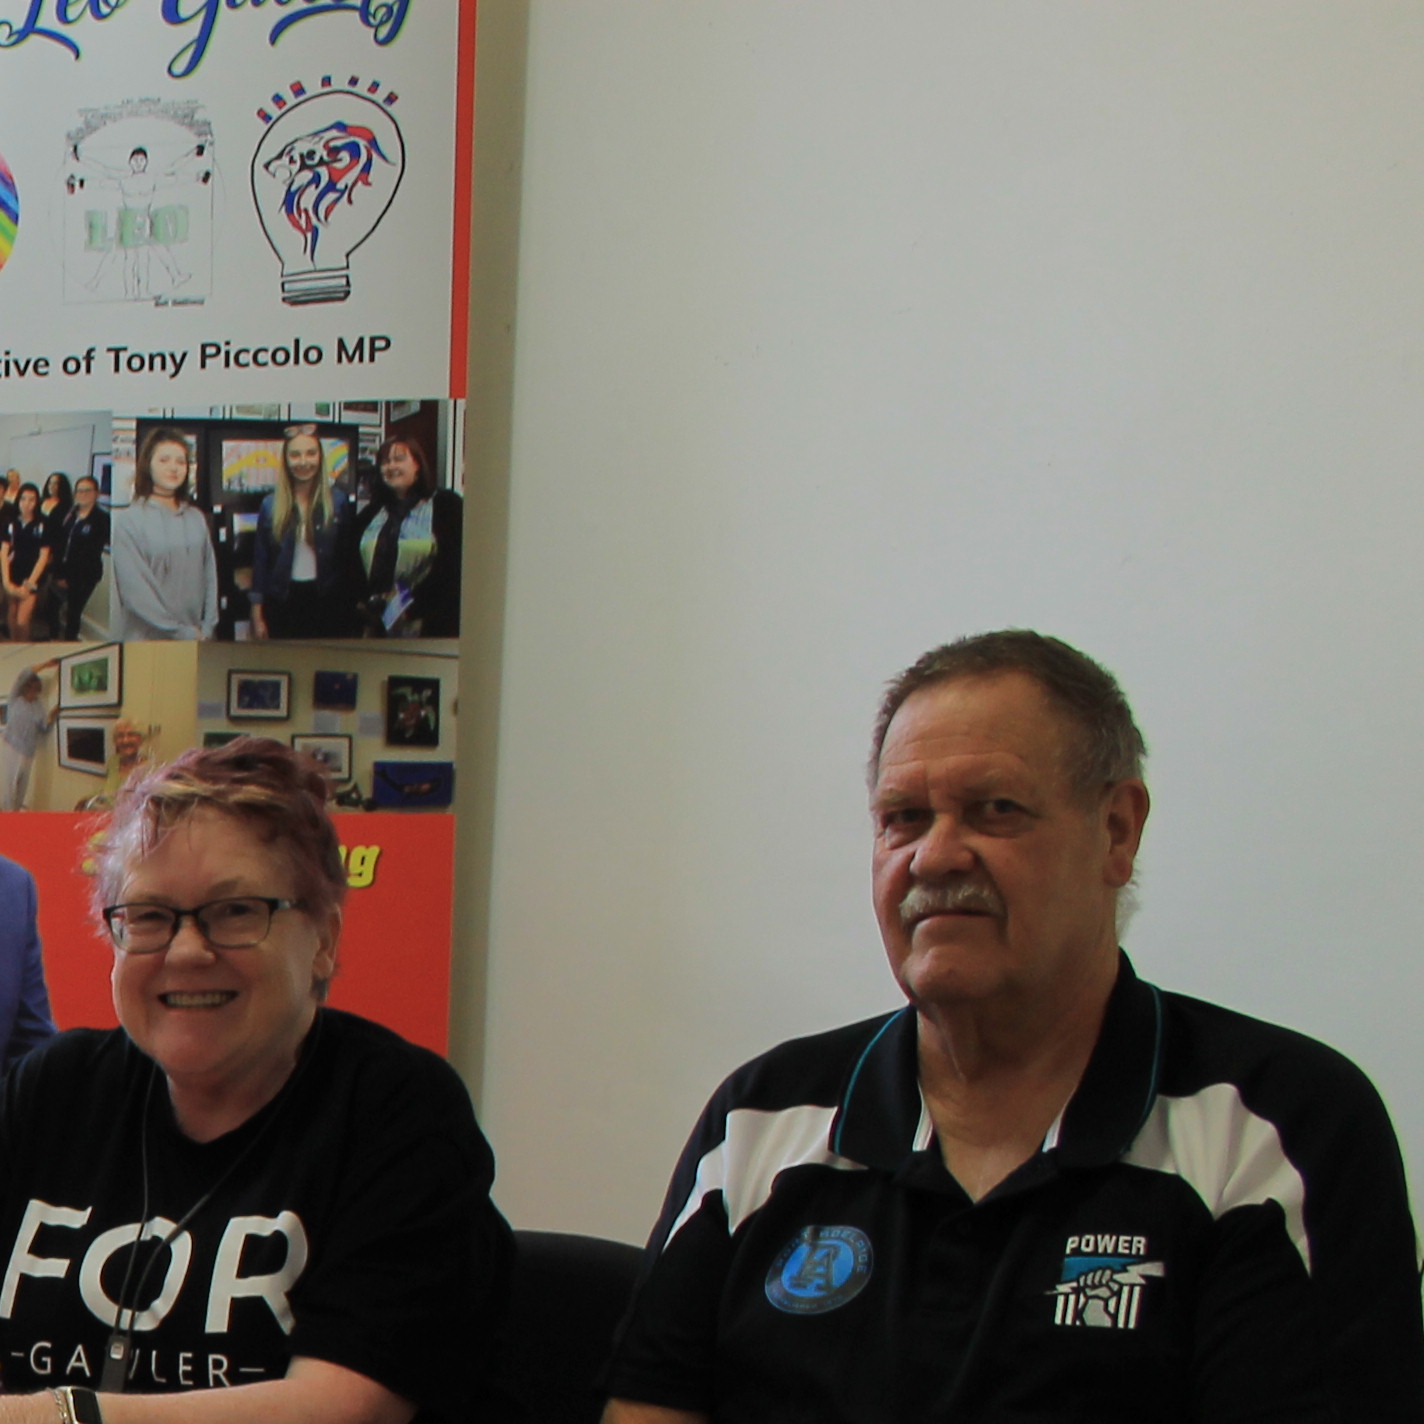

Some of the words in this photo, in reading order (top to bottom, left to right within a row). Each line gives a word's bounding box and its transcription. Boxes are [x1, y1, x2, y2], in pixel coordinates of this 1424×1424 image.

[84, 204, 189, 251] LEO
[61, 347, 96, 377] of
[105, 345, 188, 379] Tony
[199, 338, 324, 370] Piccolo
[336, 335, 392, 366] MP
[1065, 1234, 1146, 1255] POWER
